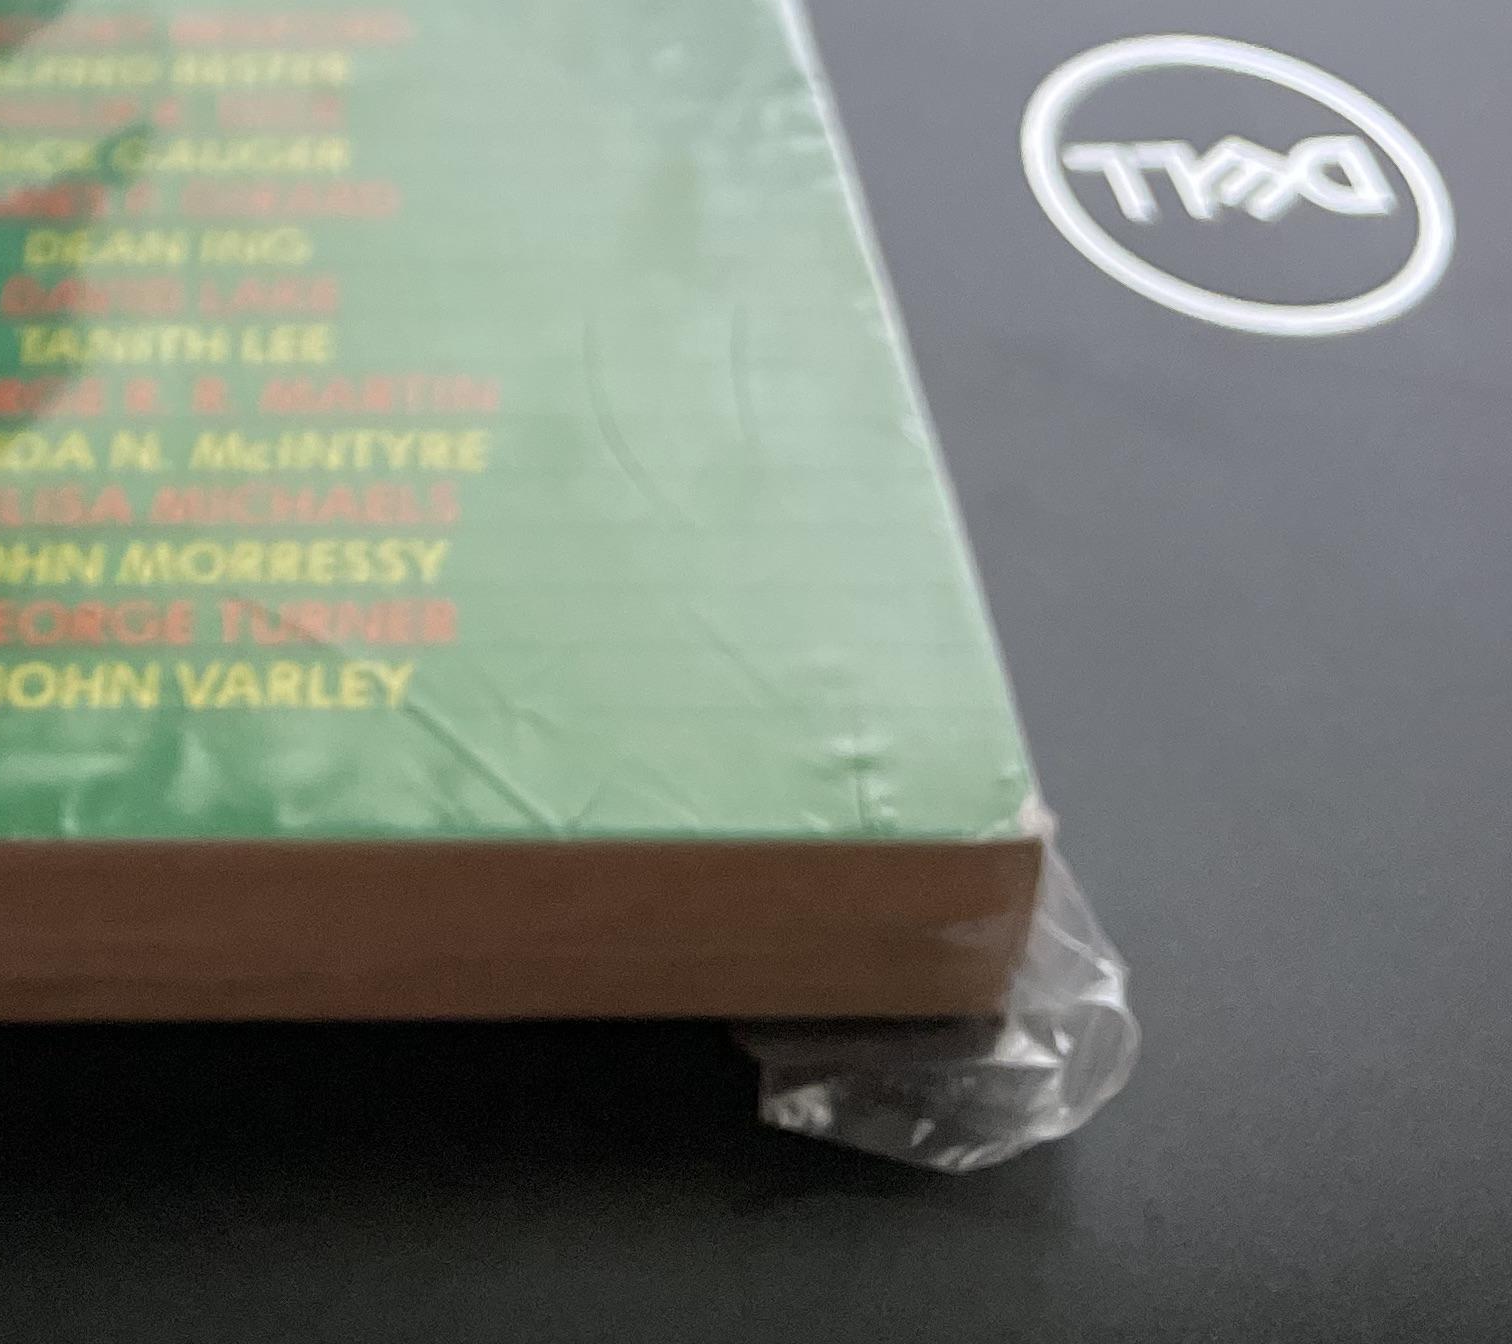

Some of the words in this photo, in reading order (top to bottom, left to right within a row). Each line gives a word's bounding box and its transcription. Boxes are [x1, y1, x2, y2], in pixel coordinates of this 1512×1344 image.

[1062, 135, 1398, 223] DELL
[22, 227, 190, 267] DEAN
[198, 226, 314, 266] ING
[18, 325, 230, 366] TANITH
[240, 324, 333, 365] LEE
[258, 375, 502, 417] MARTIN
[109, 428, 171, 473] N.
[188, 427, 492, 474] McINTYRE
[151, 480, 463, 526] MICHAELS
[116, 539, 450, 586] MORRESSY
[216, 597, 461, 645] TURNER
[171, 659, 416, 712] VARLEY
